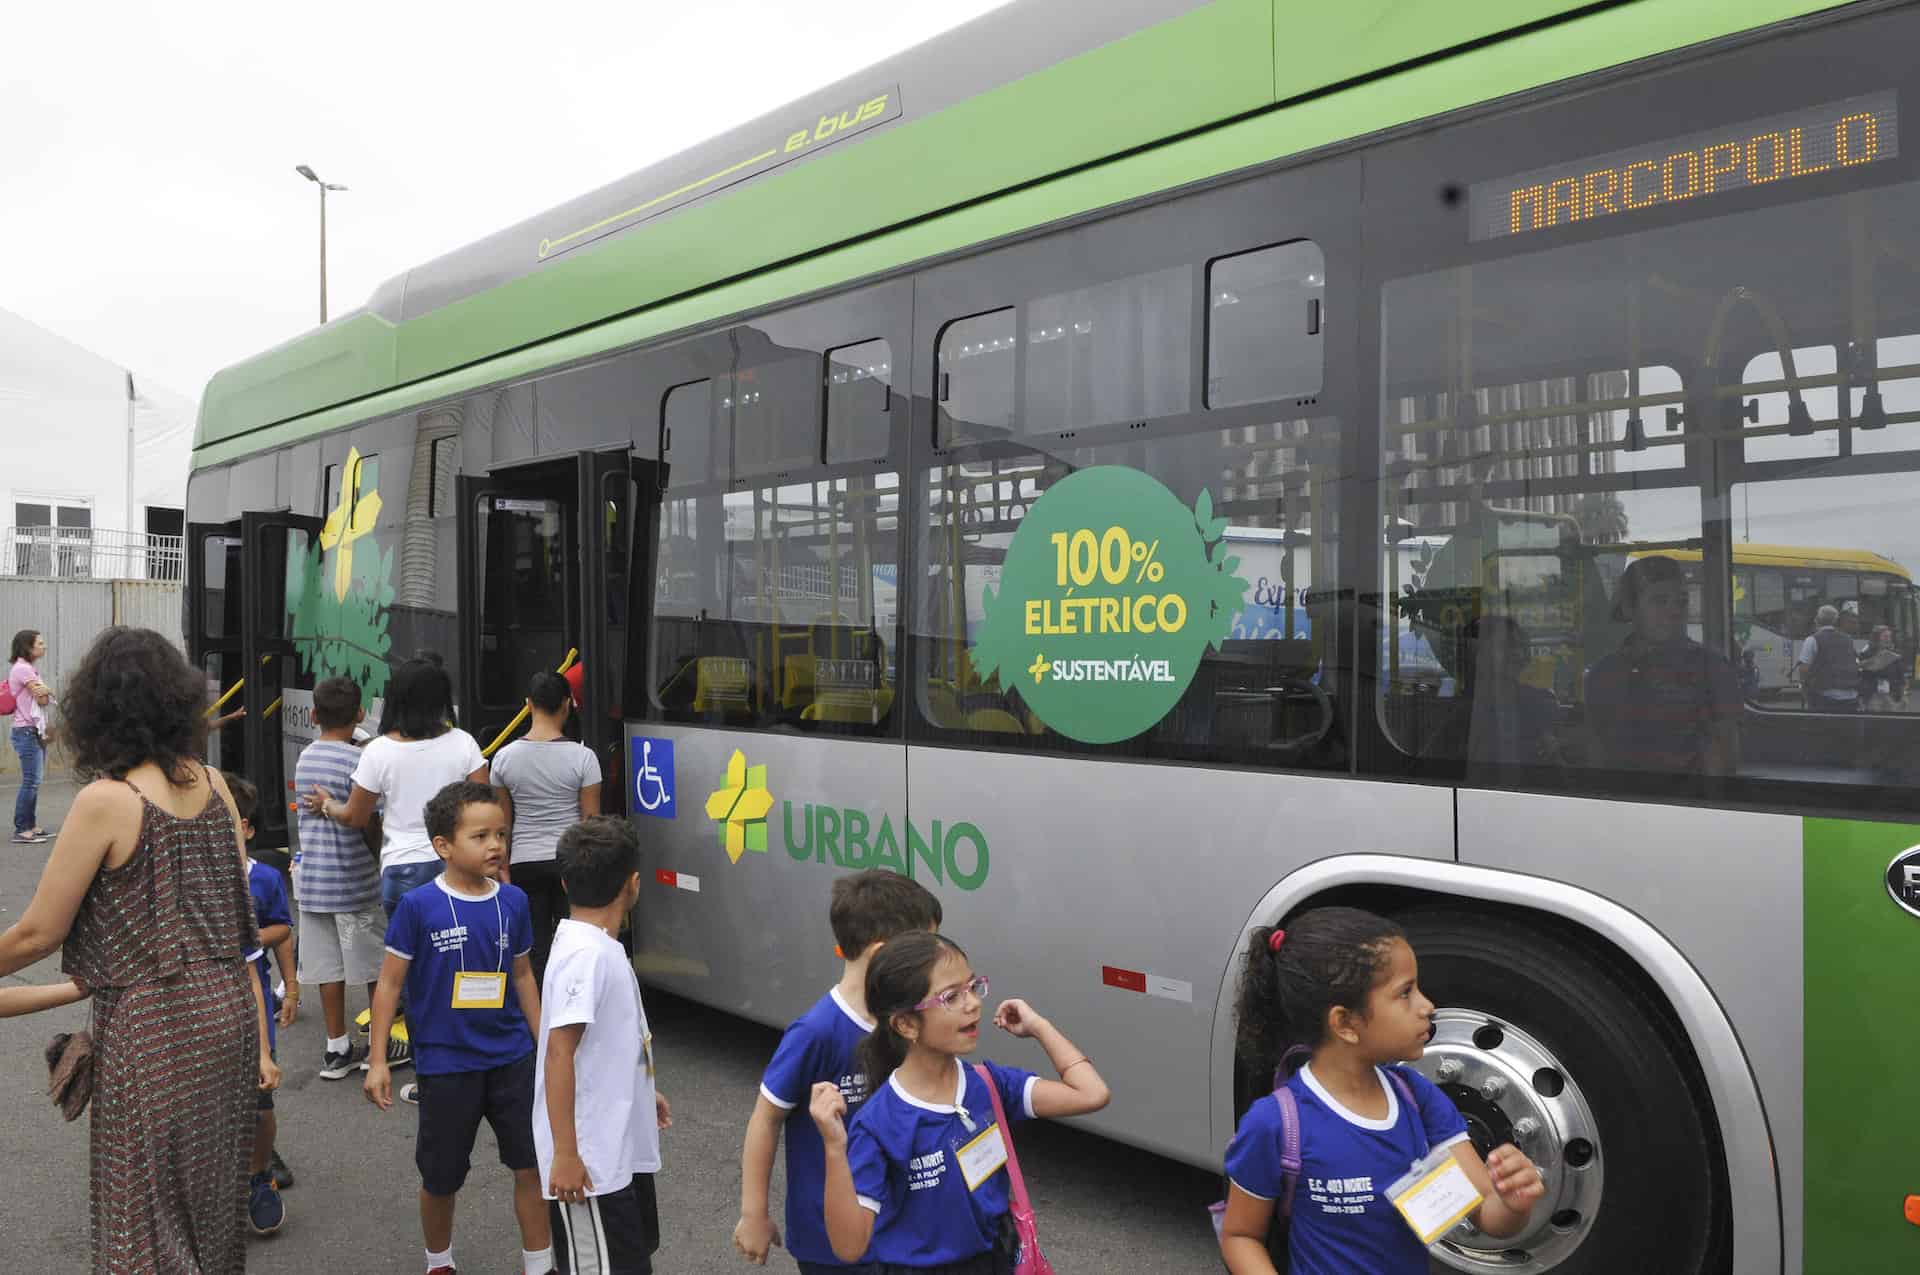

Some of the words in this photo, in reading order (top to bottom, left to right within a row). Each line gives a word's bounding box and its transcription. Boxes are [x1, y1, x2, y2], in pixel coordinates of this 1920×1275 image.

[783, 93, 888, 153] e.bus
[1510, 111, 1878, 233] MARCOPOLO
[1051, 525, 1164, 587] 100%
[1024, 587, 1187, 636] ELÉTRICO
[1052, 653, 1176, 682] SUSTENTÁVEL
[783, 799, 991, 892] URBANO
[921, 1150, 945, 1169] NORTE
[1327, 1179, 1343, 1194] 403
[1343, 1177, 1373, 1193] NORTE
